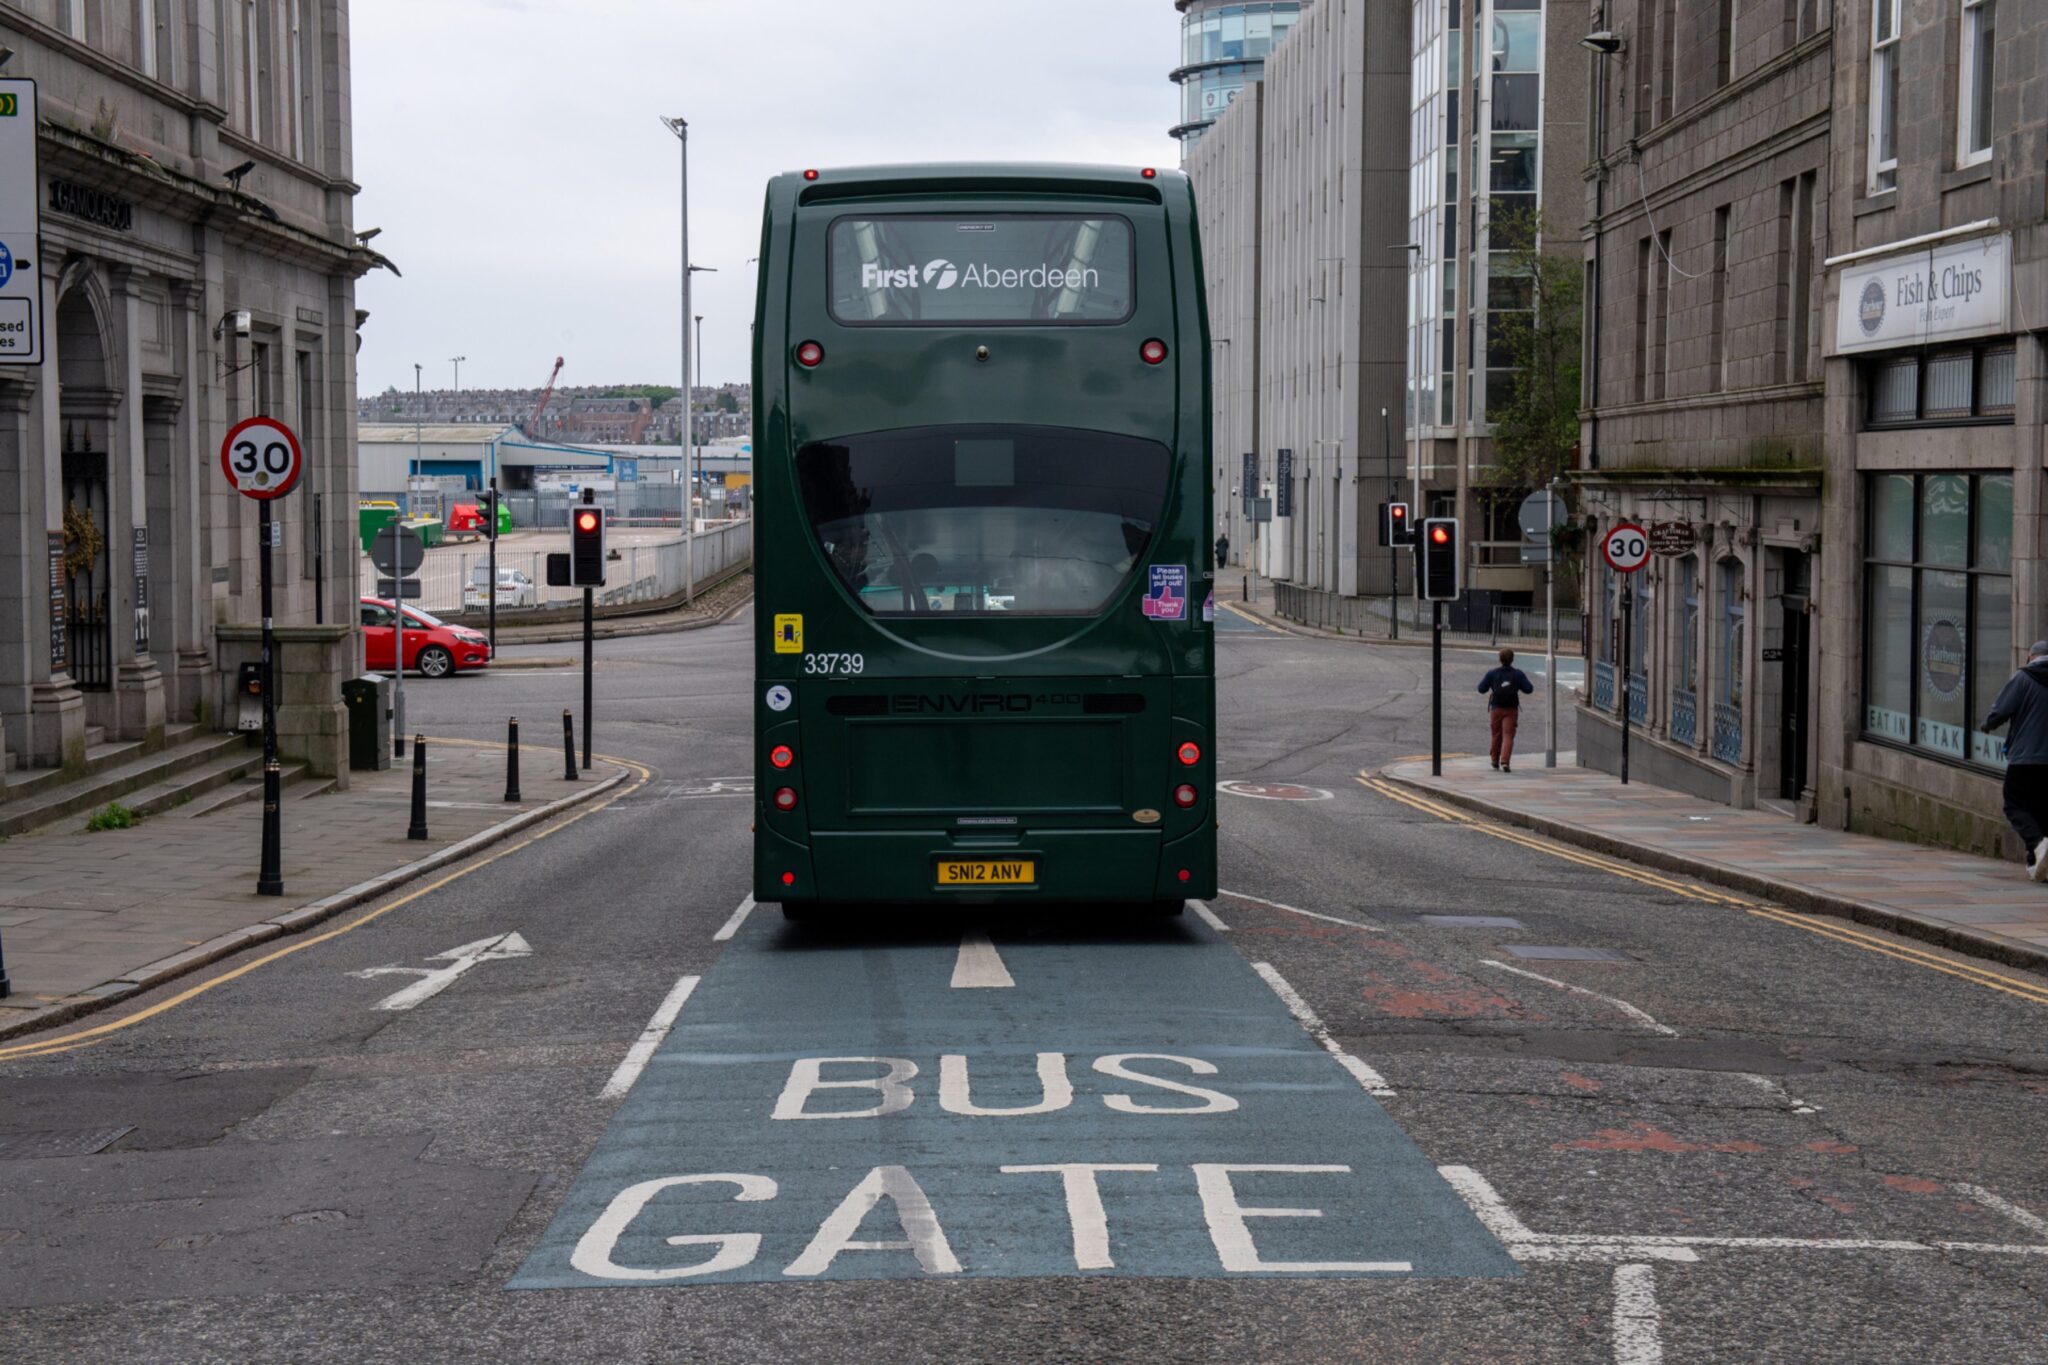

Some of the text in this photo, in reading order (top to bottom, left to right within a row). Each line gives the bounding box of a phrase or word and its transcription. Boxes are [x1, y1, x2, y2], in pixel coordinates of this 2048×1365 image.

[862, 263, 1098, 288] First Aberdeen
[1896, 264, 1982, 307] Fish & Chips
[234, 441, 290, 474] 30
[1610, 538, 1645, 557] 30
[804, 653, 864, 674] 33739
[892, 693, 1081, 713] ENVIRO 400
[1869, 710, 1889, 731] EAT
[1894, 717, 1906, 736] IN
[948, 864, 1022, 880] SN12 ANV
[770, 1052, 1240, 1121] BUS
[569, 1163, 1413, 1281] GATE
